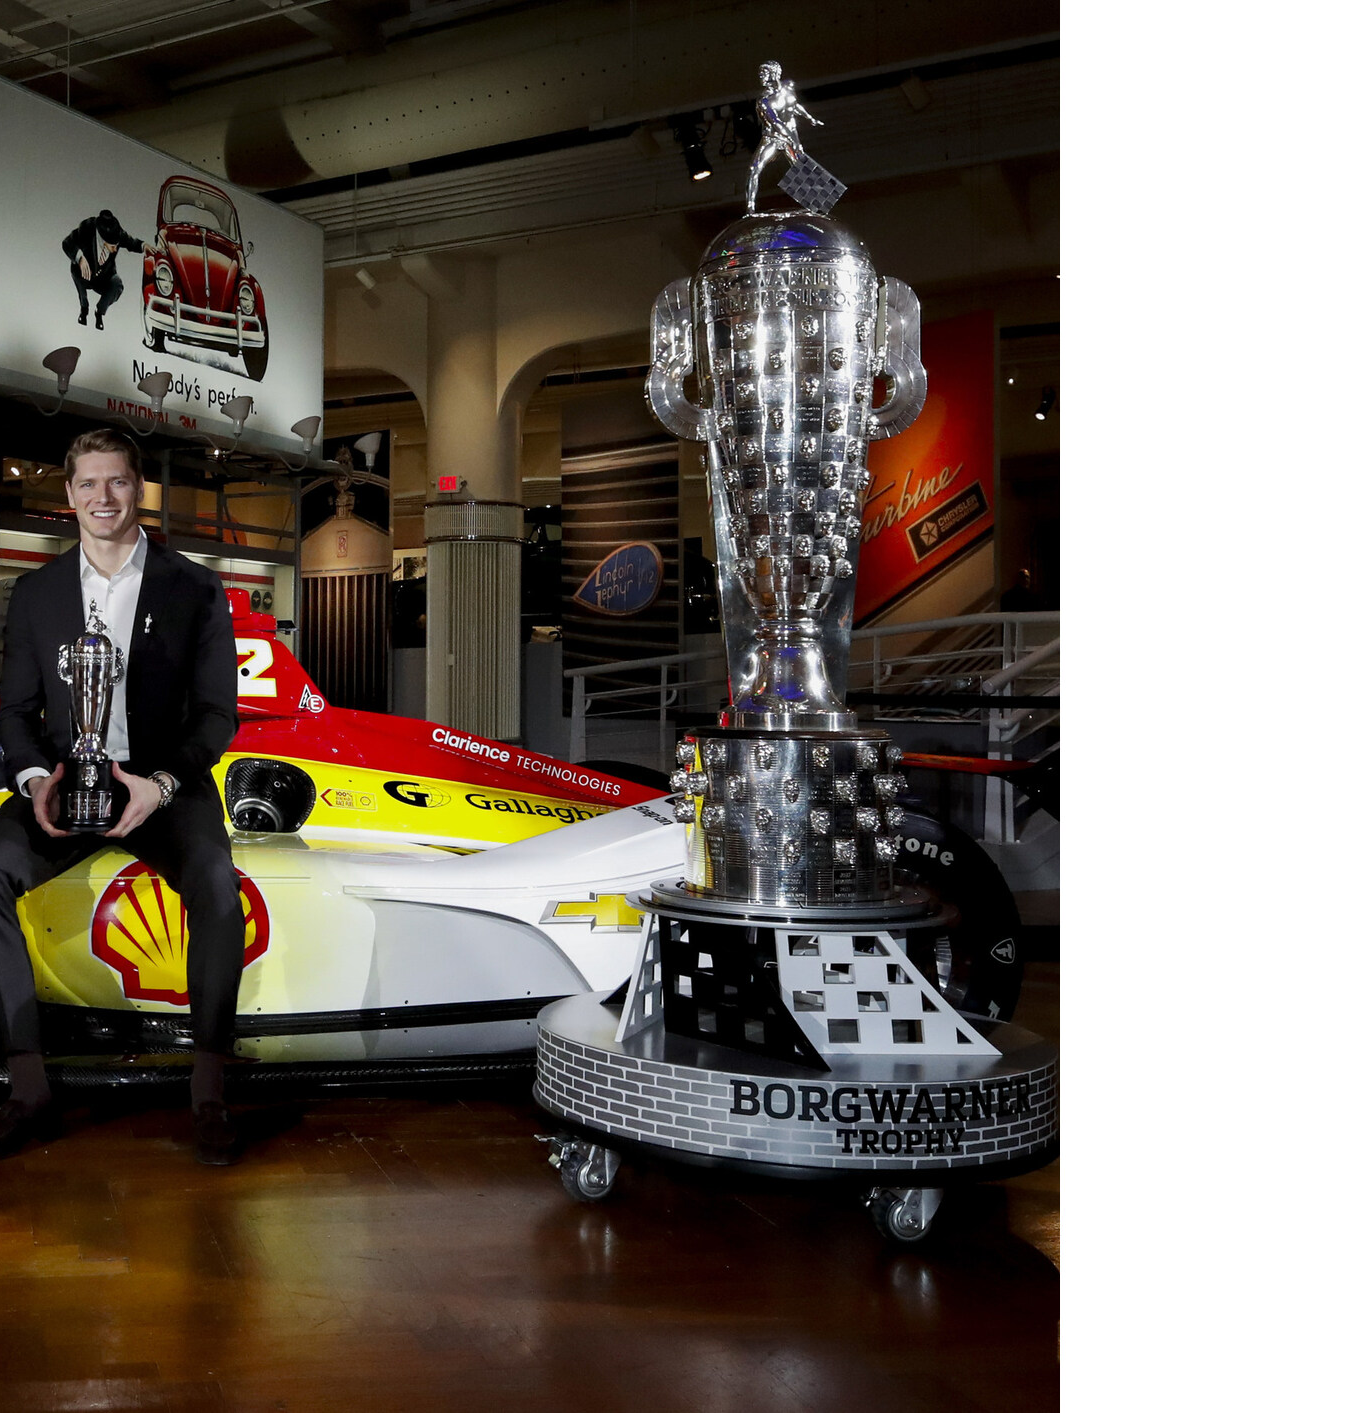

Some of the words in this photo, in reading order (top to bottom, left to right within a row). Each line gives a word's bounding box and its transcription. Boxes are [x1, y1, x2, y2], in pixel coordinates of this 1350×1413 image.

[132, 359, 201, 402] Nody's
[937, 494, 978, 527] CHRYSLER
[594, 552, 634, 588] Lincoln
[235, 637, 277, 698] 2
[432, 727, 511, 763] Clarience
[516, 754, 621, 796] TECHNOLOGIES
[465, 793, 603, 824] Gallagh
[729, 1077, 1031, 1124] BORGWARNER
[836, 1128, 966, 1154] TROPHY
